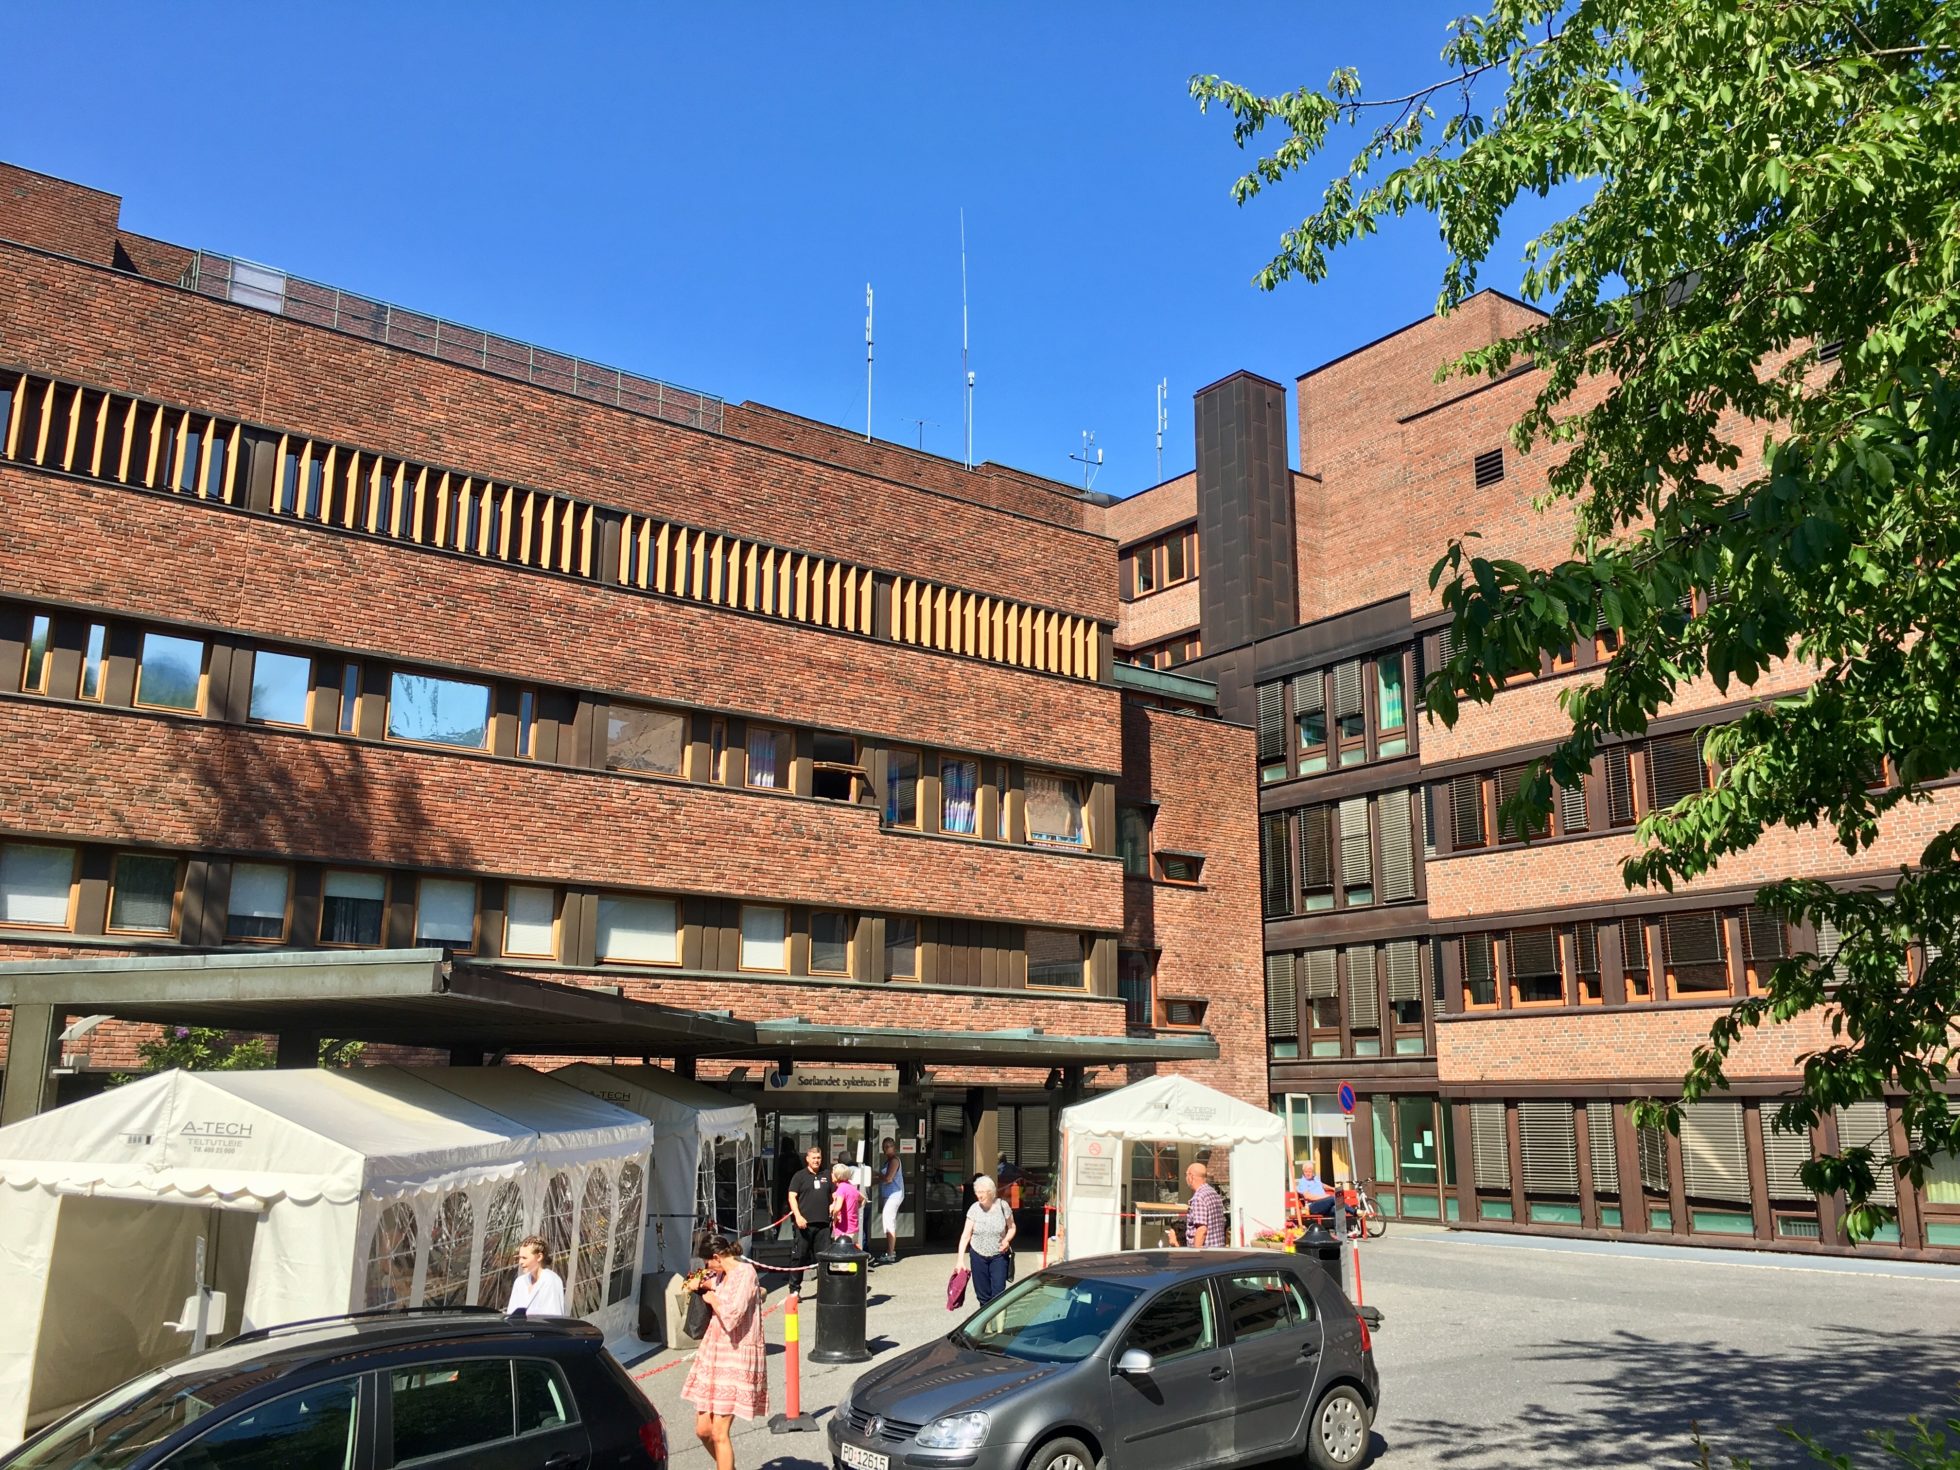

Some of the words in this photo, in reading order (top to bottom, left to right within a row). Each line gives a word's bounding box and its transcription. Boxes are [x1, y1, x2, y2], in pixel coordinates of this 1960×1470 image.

[842, 1076, 877, 1089] sykehus
[878, 1077, 892, 1087] HF
[181, 1121, 253, 1135] A-TECH
[188, 1138, 243, 1148] TELTUTLEIE
